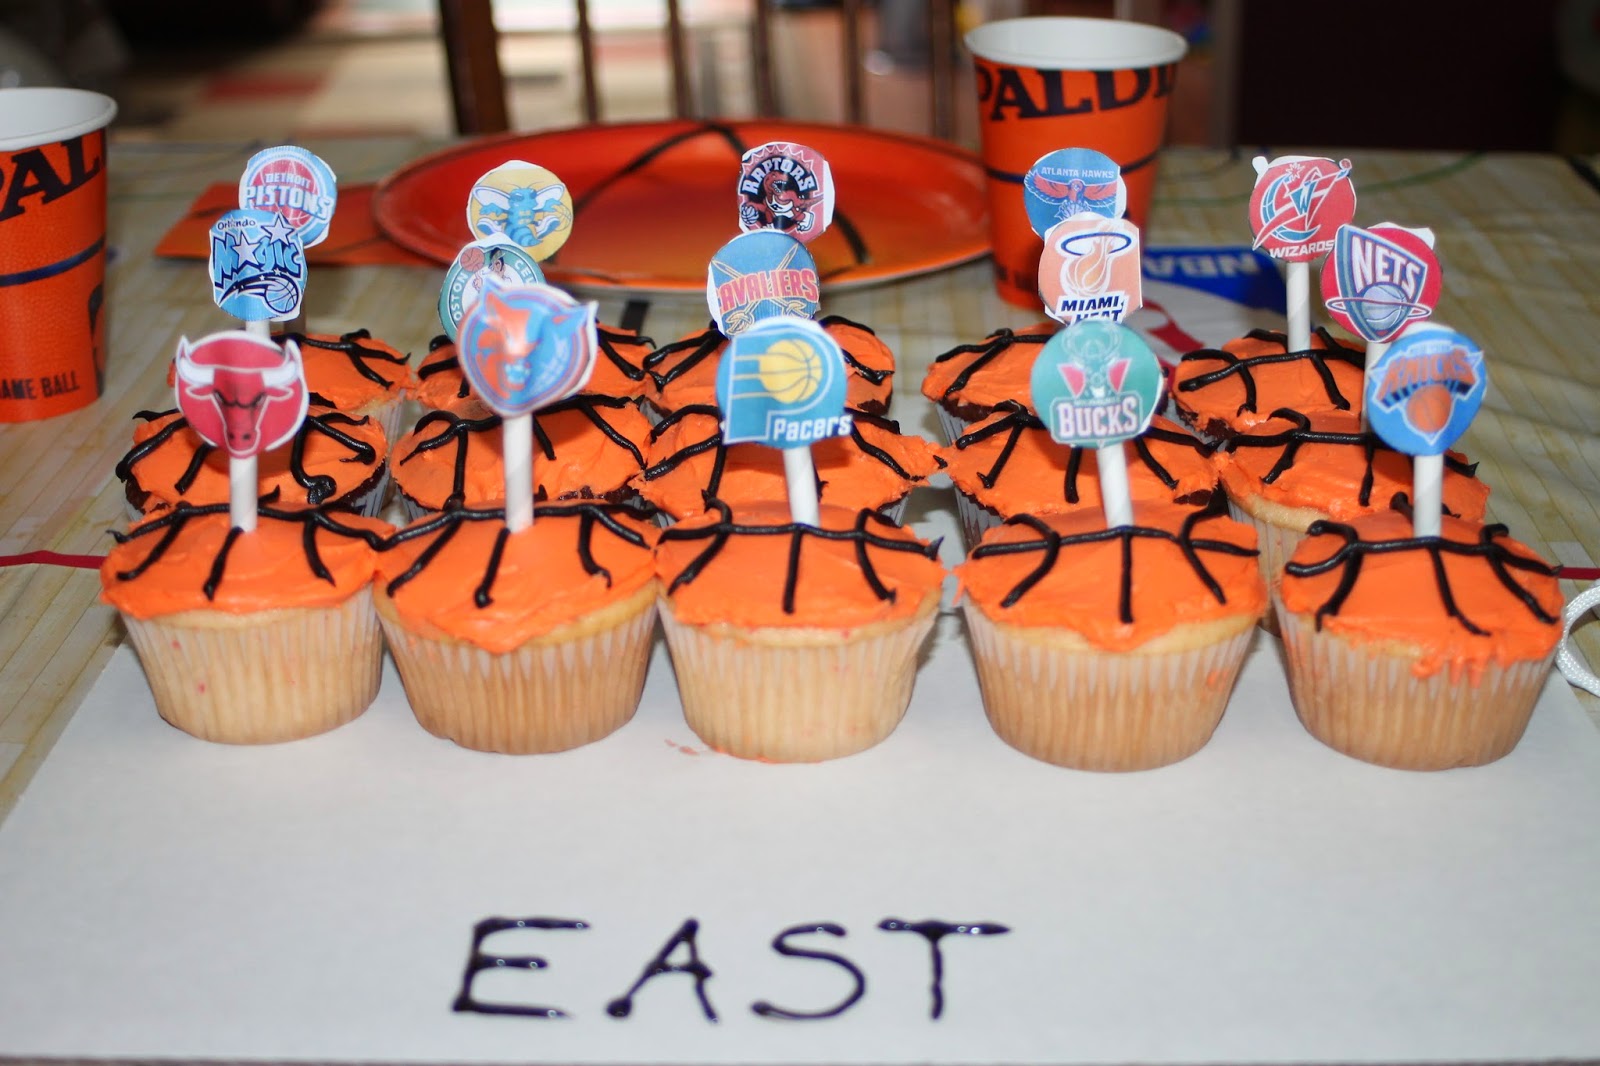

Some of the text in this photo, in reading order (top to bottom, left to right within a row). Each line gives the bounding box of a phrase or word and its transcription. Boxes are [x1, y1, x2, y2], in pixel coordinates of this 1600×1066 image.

[265, 172, 311, 188] DETROIT
[740, 156, 818, 196] RAPTORS
[1041, 166, 1115, 179] ATLANTA HAWKS
[246, 185, 333, 222] PISTONS
[1269, 240, 1335, 258] WIZARDS
[1352, 235, 1421, 300] NETS
[716, 269, 820, 315] AVALIERS
[1061, 295, 1120, 311] MIAMI
[40, 370, 80, 398] BALL
[1376, 347, 1476, 402] KNICKS
[1057, 396, 1138, 439] BUCKS
[451, 915, 1011, 1025] EAST
